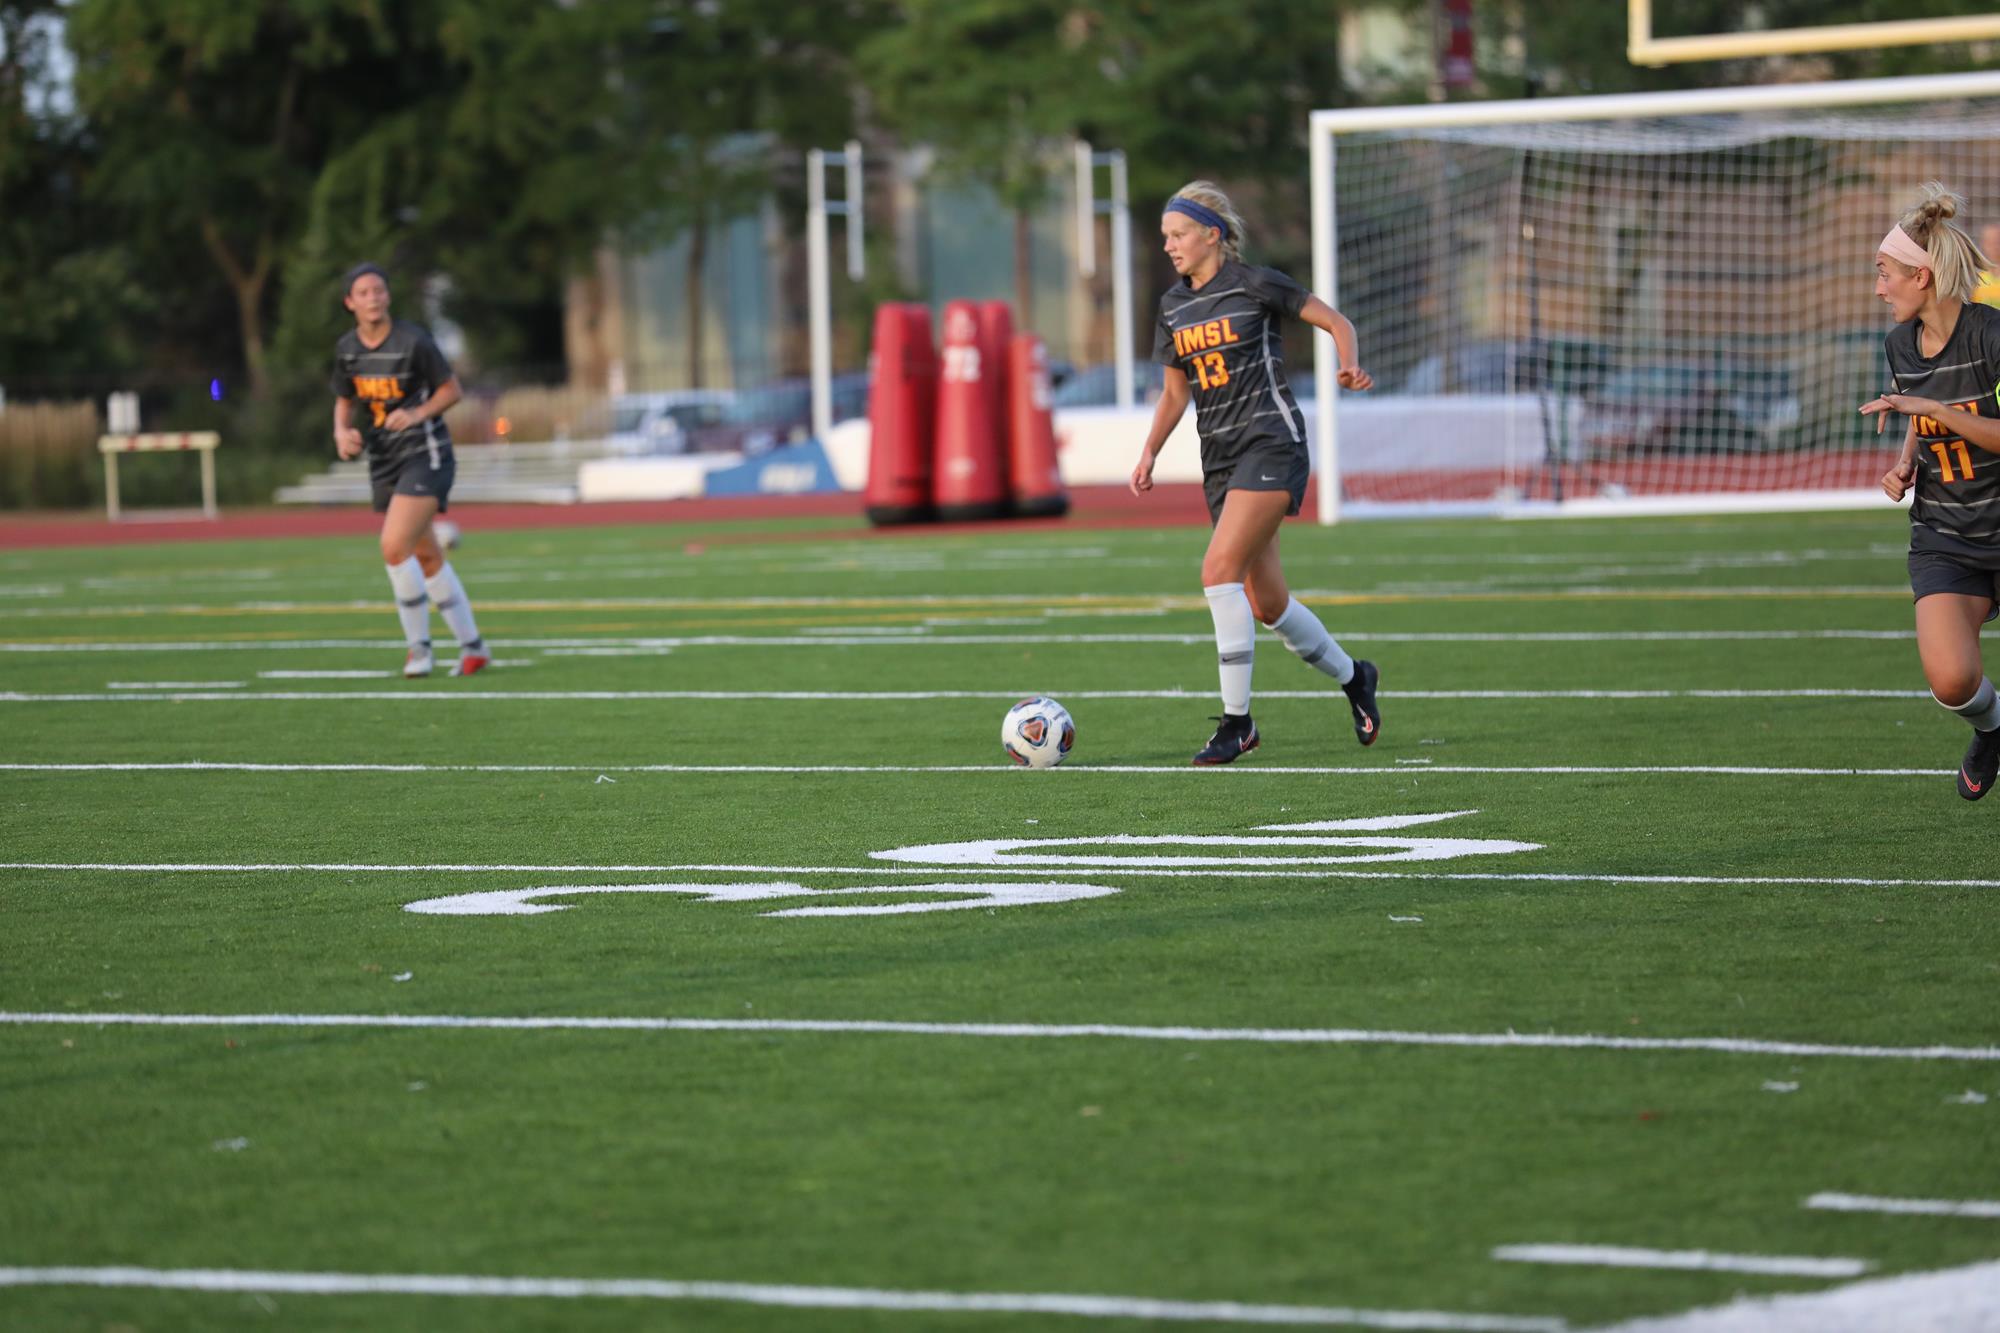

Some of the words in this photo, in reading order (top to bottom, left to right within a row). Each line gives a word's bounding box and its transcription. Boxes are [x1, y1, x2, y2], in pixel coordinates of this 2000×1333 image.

[1173, 318, 1239, 356] UMSL
[1191, 351, 1230, 390] 13
[1930, 437, 1975, 483] 11
